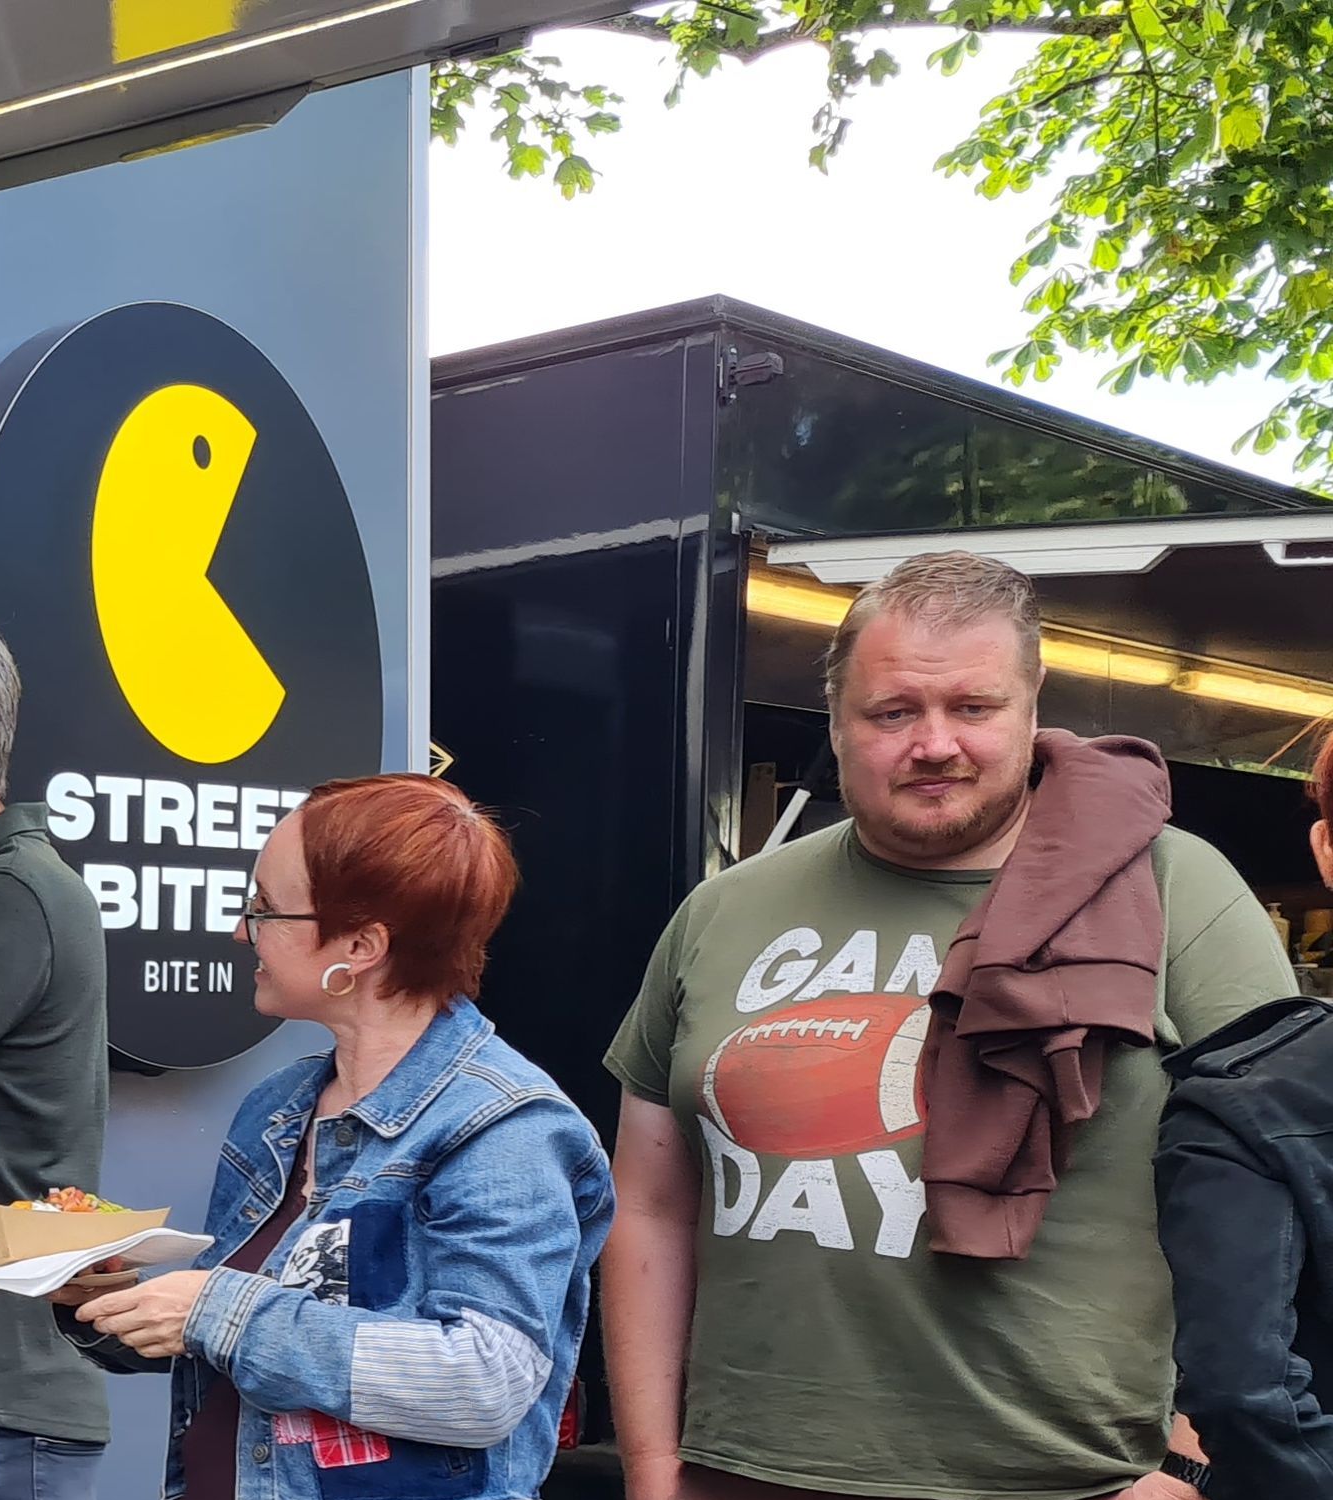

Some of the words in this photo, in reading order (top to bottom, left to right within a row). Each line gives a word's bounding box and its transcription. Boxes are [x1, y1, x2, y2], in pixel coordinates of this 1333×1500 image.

[83, 863, 257, 933] BITE
[143, 960, 200, 993] BITE
[208, 962, 233, 993] IN
[696, 1113, 928, 1259] DAY
